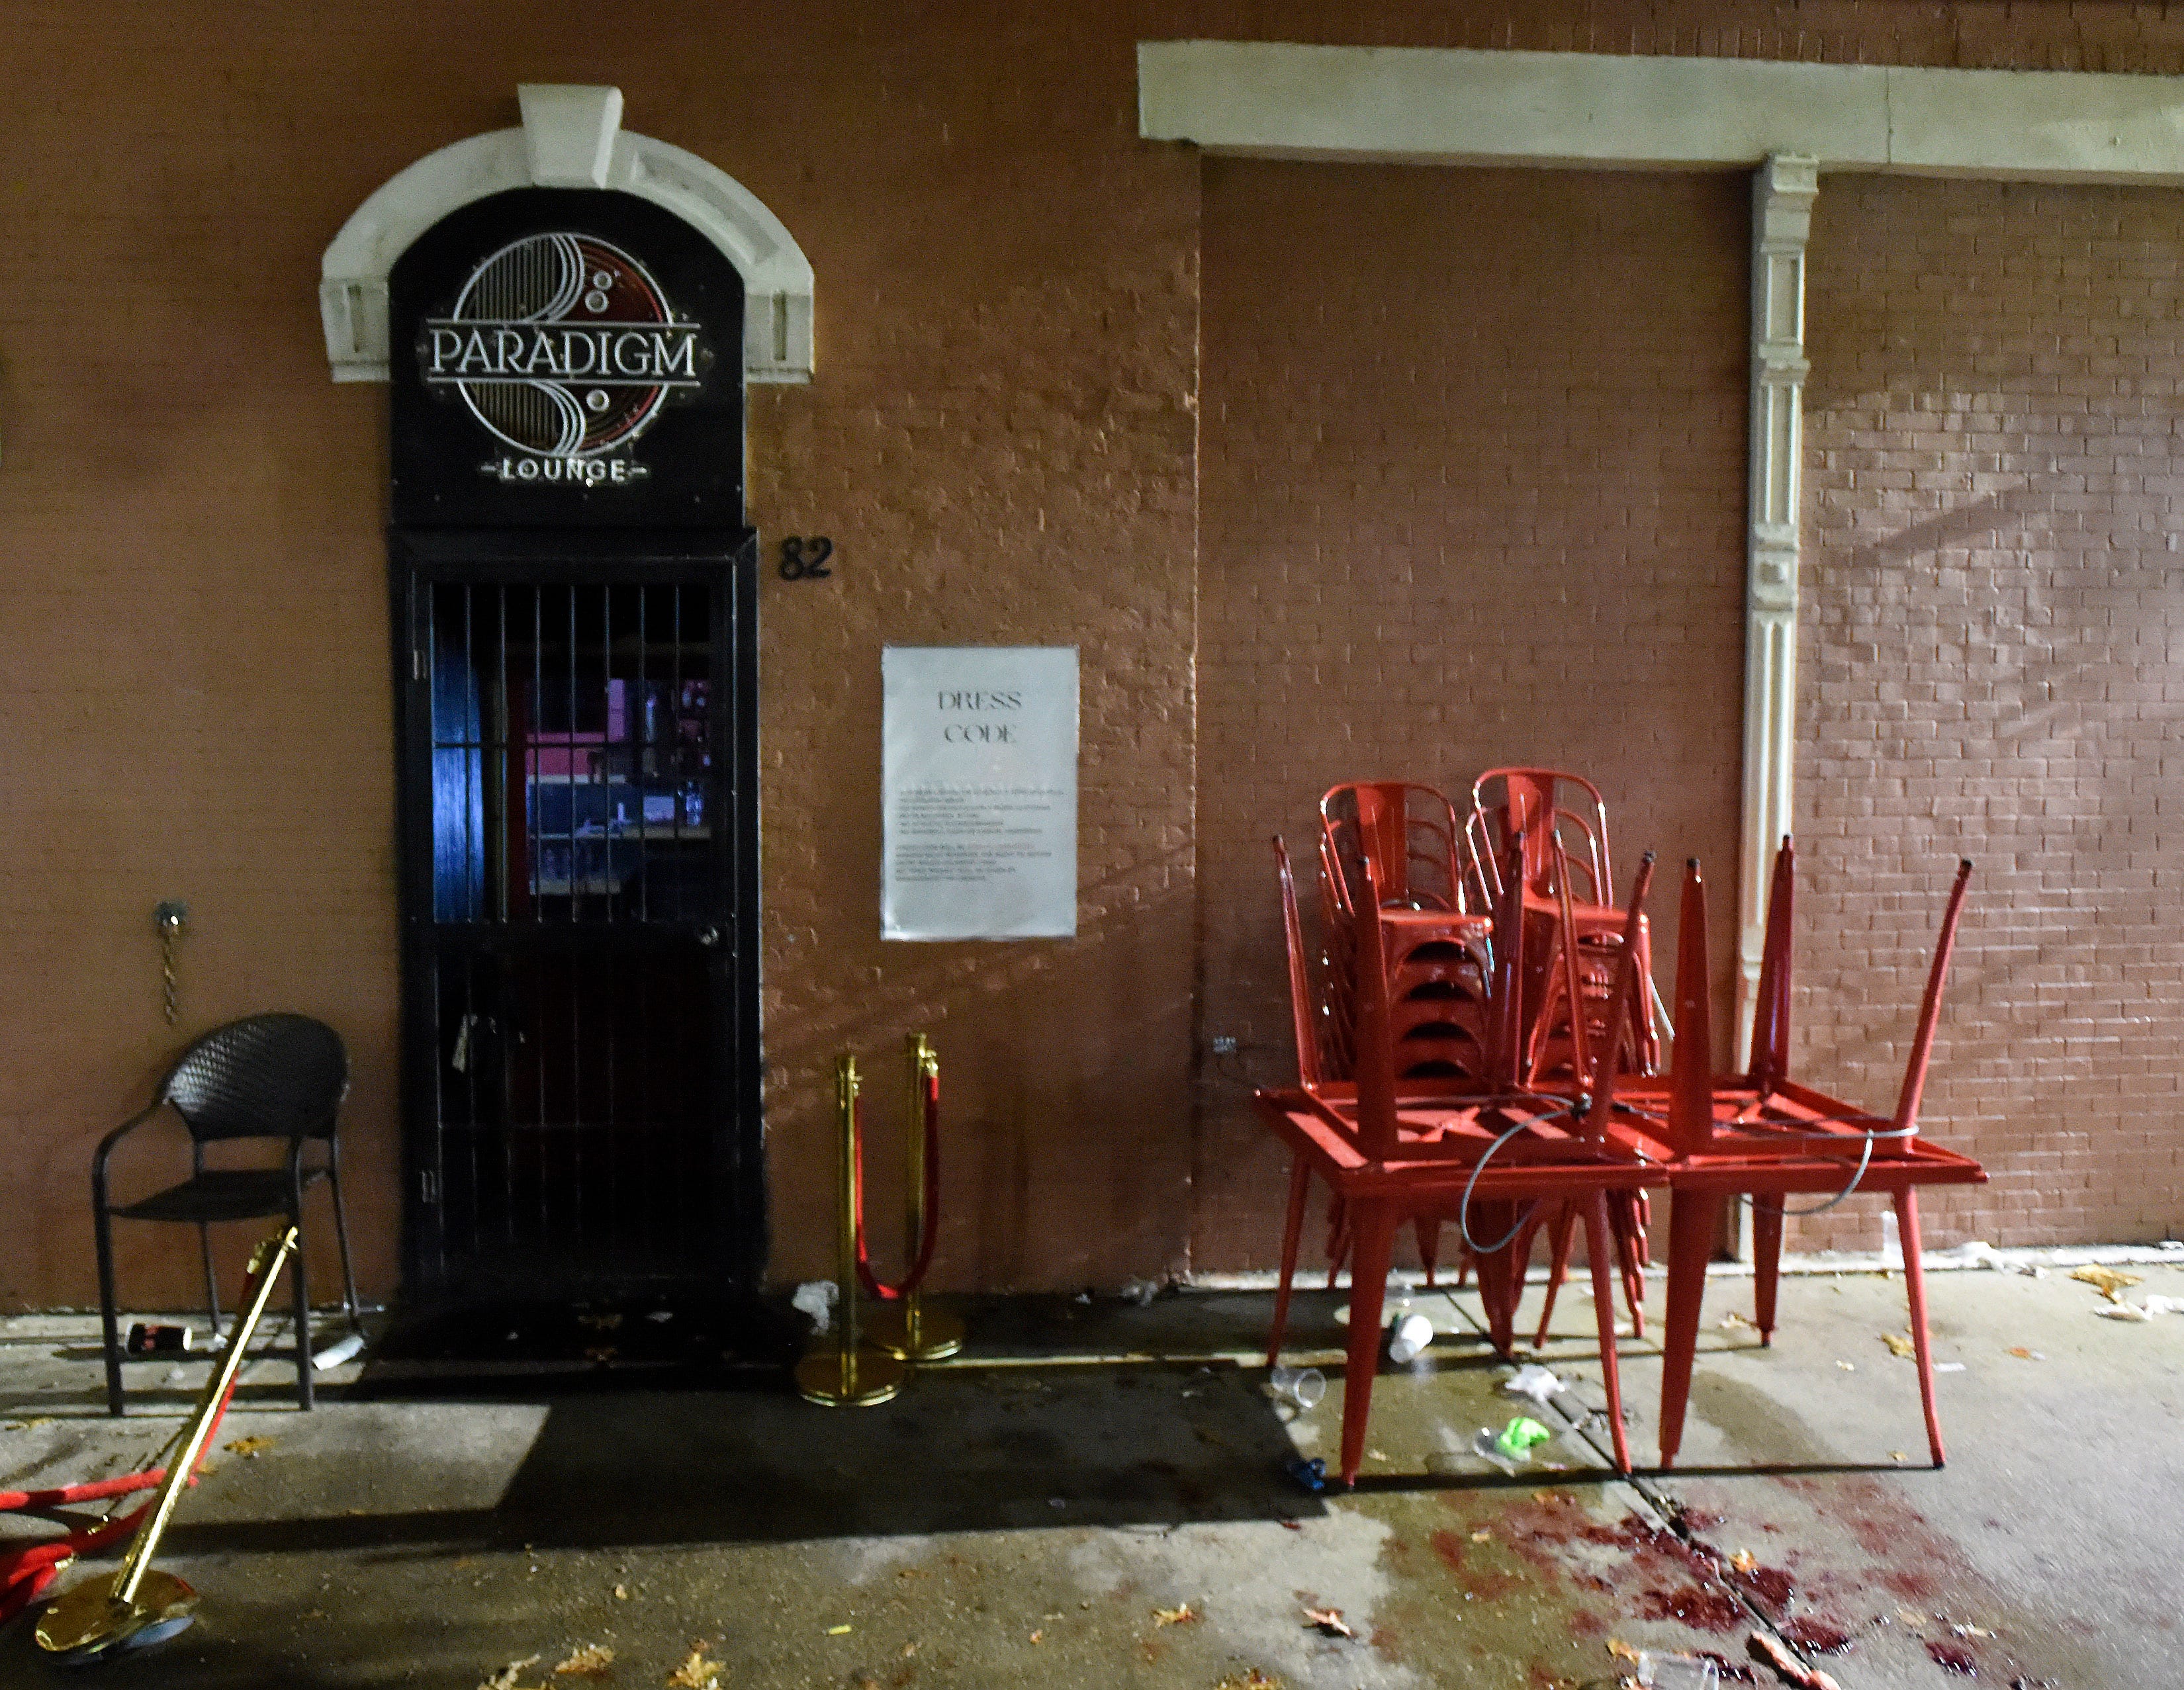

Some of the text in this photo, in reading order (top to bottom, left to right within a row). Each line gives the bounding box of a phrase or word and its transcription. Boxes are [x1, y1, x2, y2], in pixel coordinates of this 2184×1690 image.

[429, 329, 698, 377] PARADIGM
[501, 458, 625, 482] LOUNGE
[780, 535, 833, 580] 82
[937, 690, 1023, 711] DRESS
[944, 723, 1017, 744] CODE
